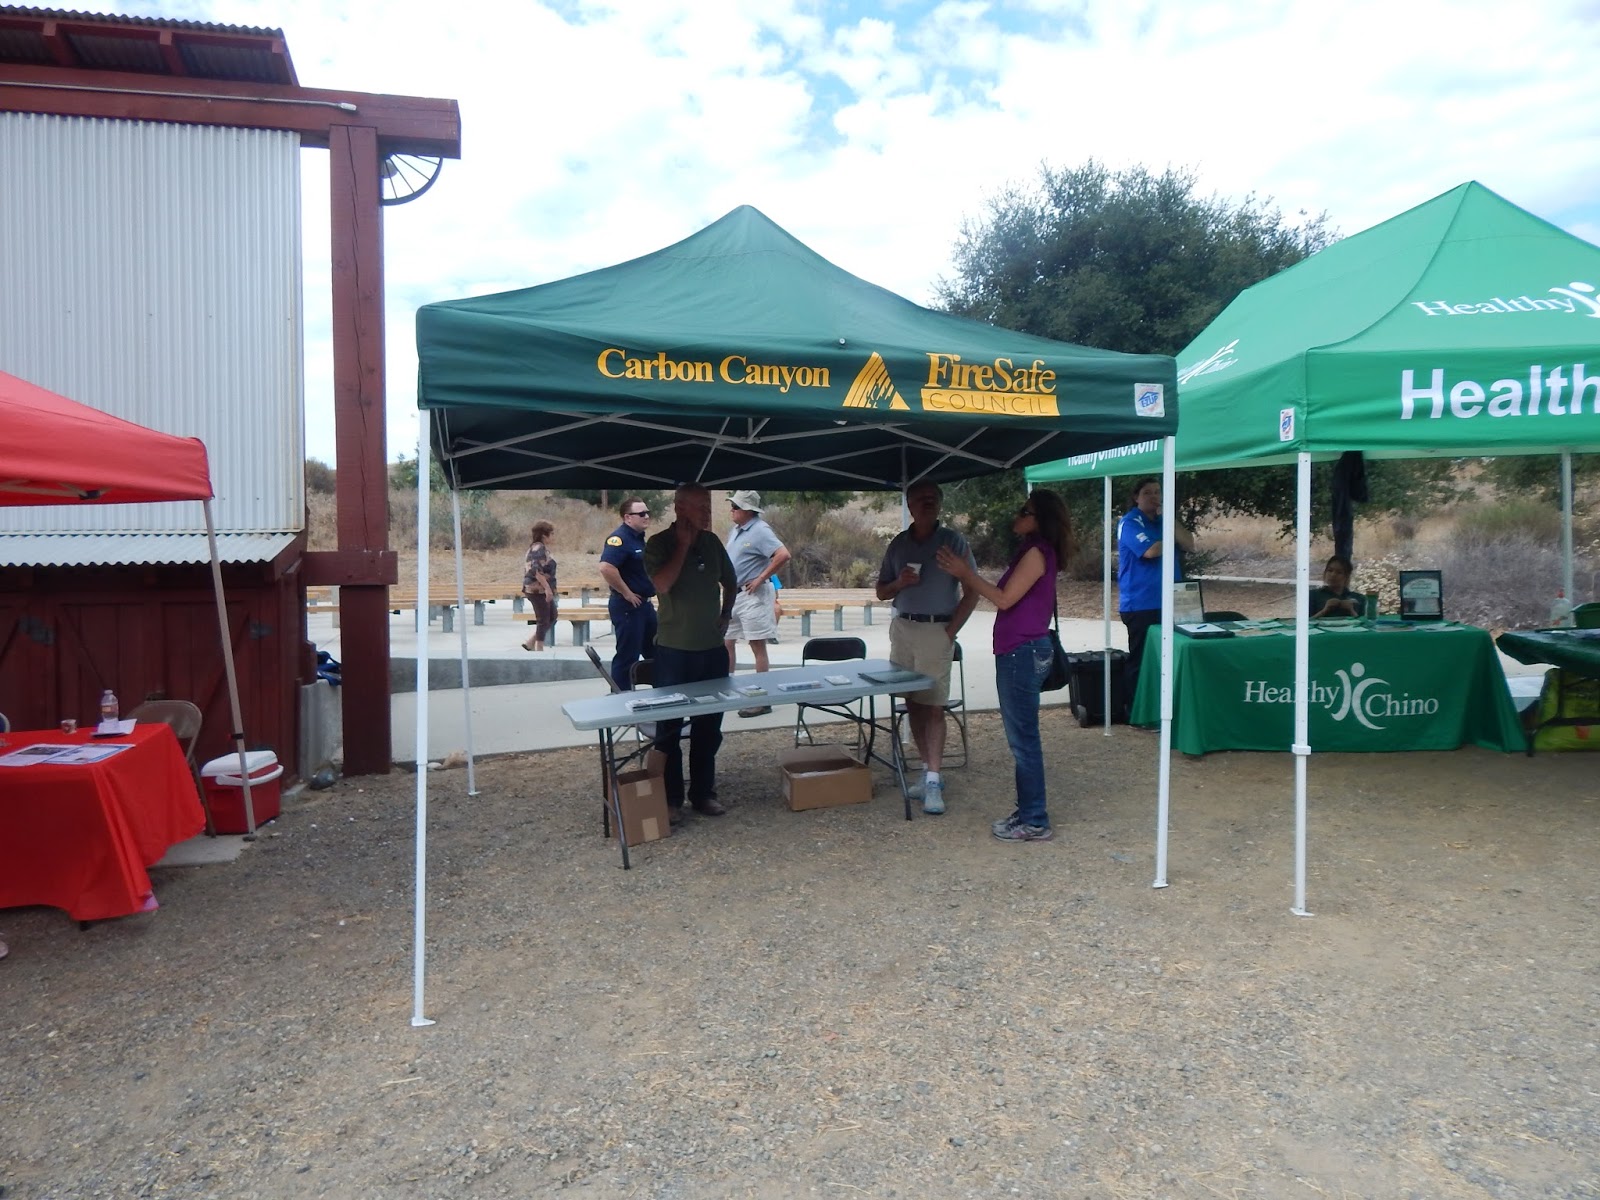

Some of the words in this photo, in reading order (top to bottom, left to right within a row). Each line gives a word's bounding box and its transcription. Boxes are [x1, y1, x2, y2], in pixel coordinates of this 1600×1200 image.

[1411, 295, 1577, 317] Healthy
[597, 348, 715, 383] Carbon
[719, 355, 831, 393] Canyon
[924, 352, 1057, 394] FireSafe
[929, 392, 1050, 414] COUNCIL
[1400, 363, 1600, 420] Health
[1243, 680, 1341, 709] Heahy
[1365, 692, 1440, 718] Chino
